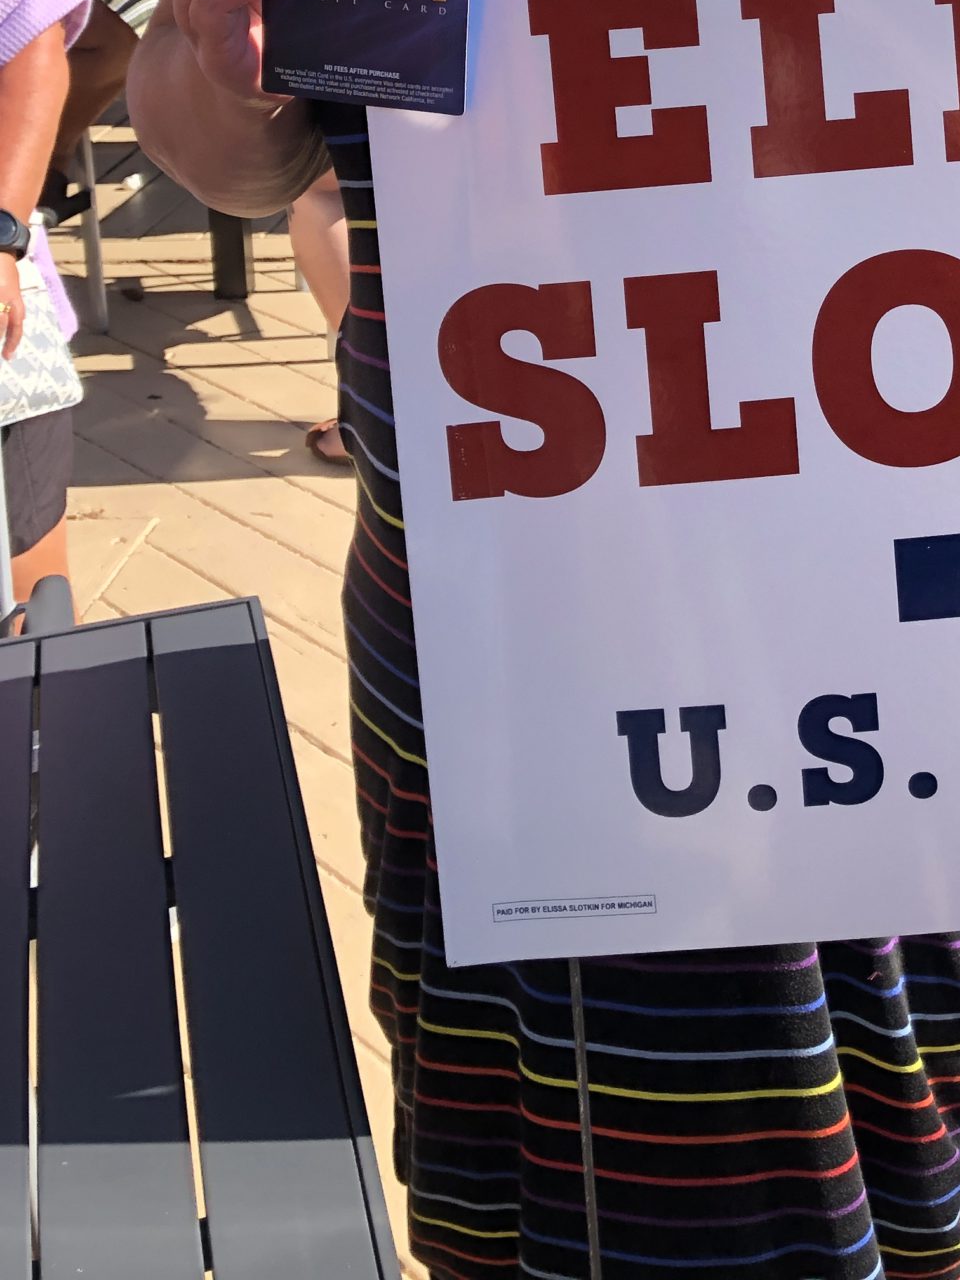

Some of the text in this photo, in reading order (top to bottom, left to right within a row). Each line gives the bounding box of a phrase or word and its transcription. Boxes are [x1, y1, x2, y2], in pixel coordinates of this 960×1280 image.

[384, 0, 447, 16] CARD
[369, 69, 400, 79] PURCHASE
[615, 692, 939, 819] U.S.
[514, 906, 530, 915] FOR
[531, 906, 541, 914] BY
[542, 904, 568, 913] ELISSA
[568, 902, 600, 912] SLOTKIN
[617, 900, 653, 910] MICHIGAN
